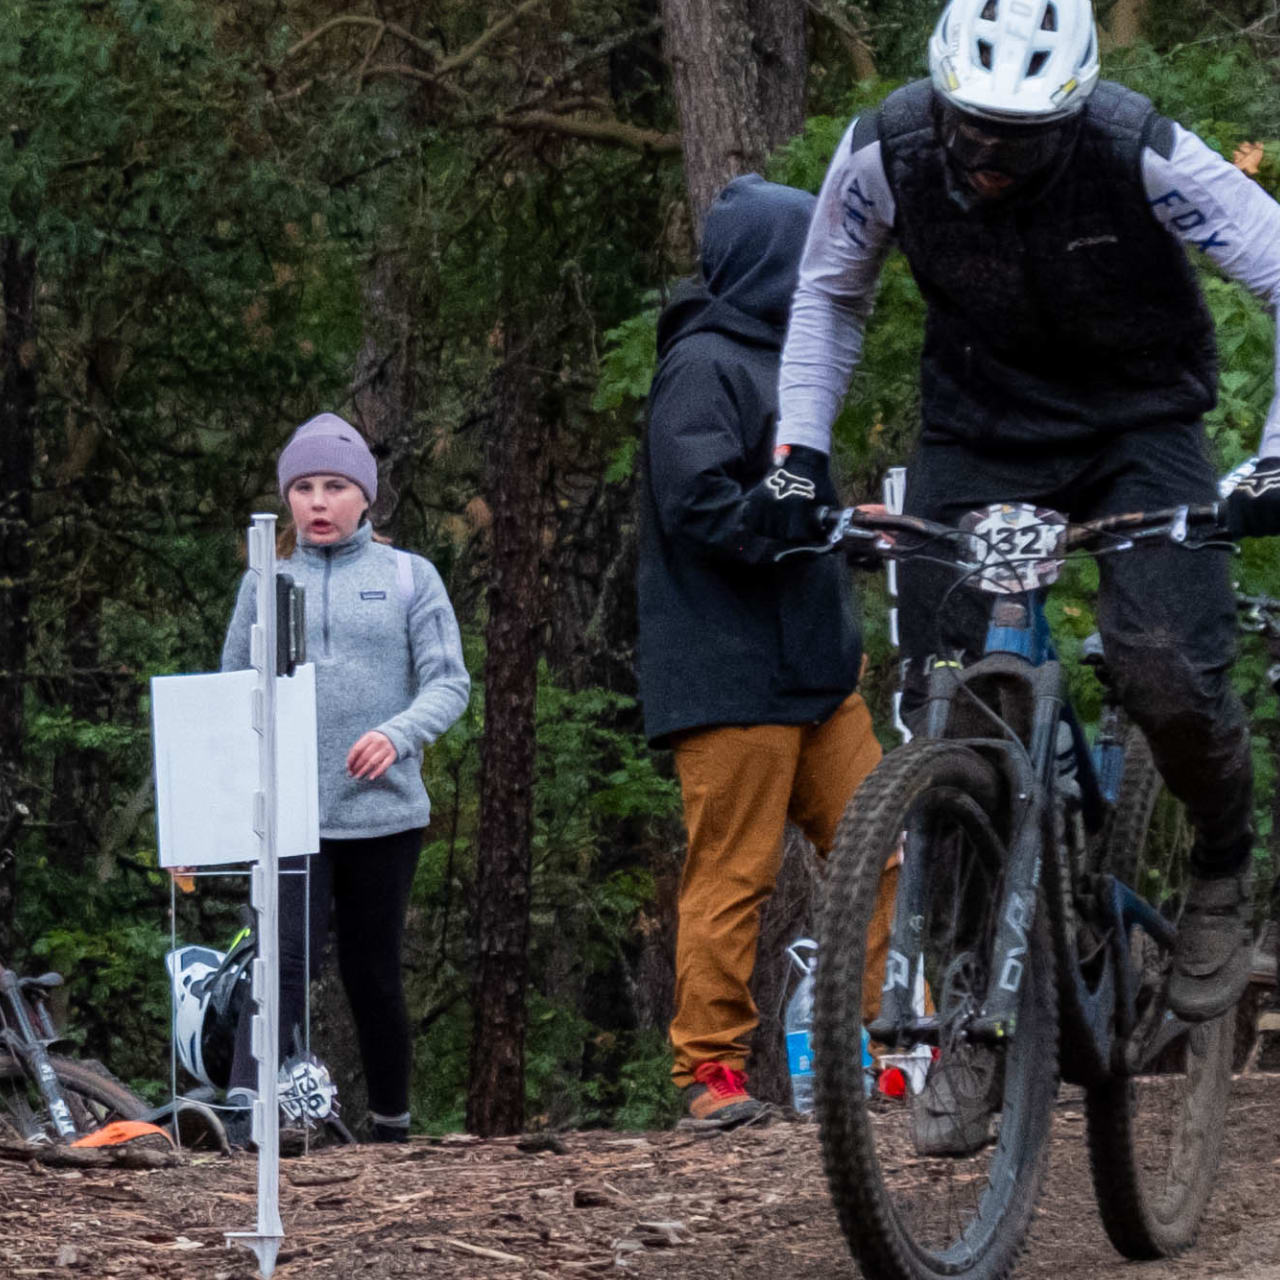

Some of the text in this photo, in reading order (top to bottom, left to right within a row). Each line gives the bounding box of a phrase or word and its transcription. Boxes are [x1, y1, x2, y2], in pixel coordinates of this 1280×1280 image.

[1147, 189, 1231, 253] FOX
[980, 526, 1042, 557] 132
[294, 1067, 327, 1112] 136
